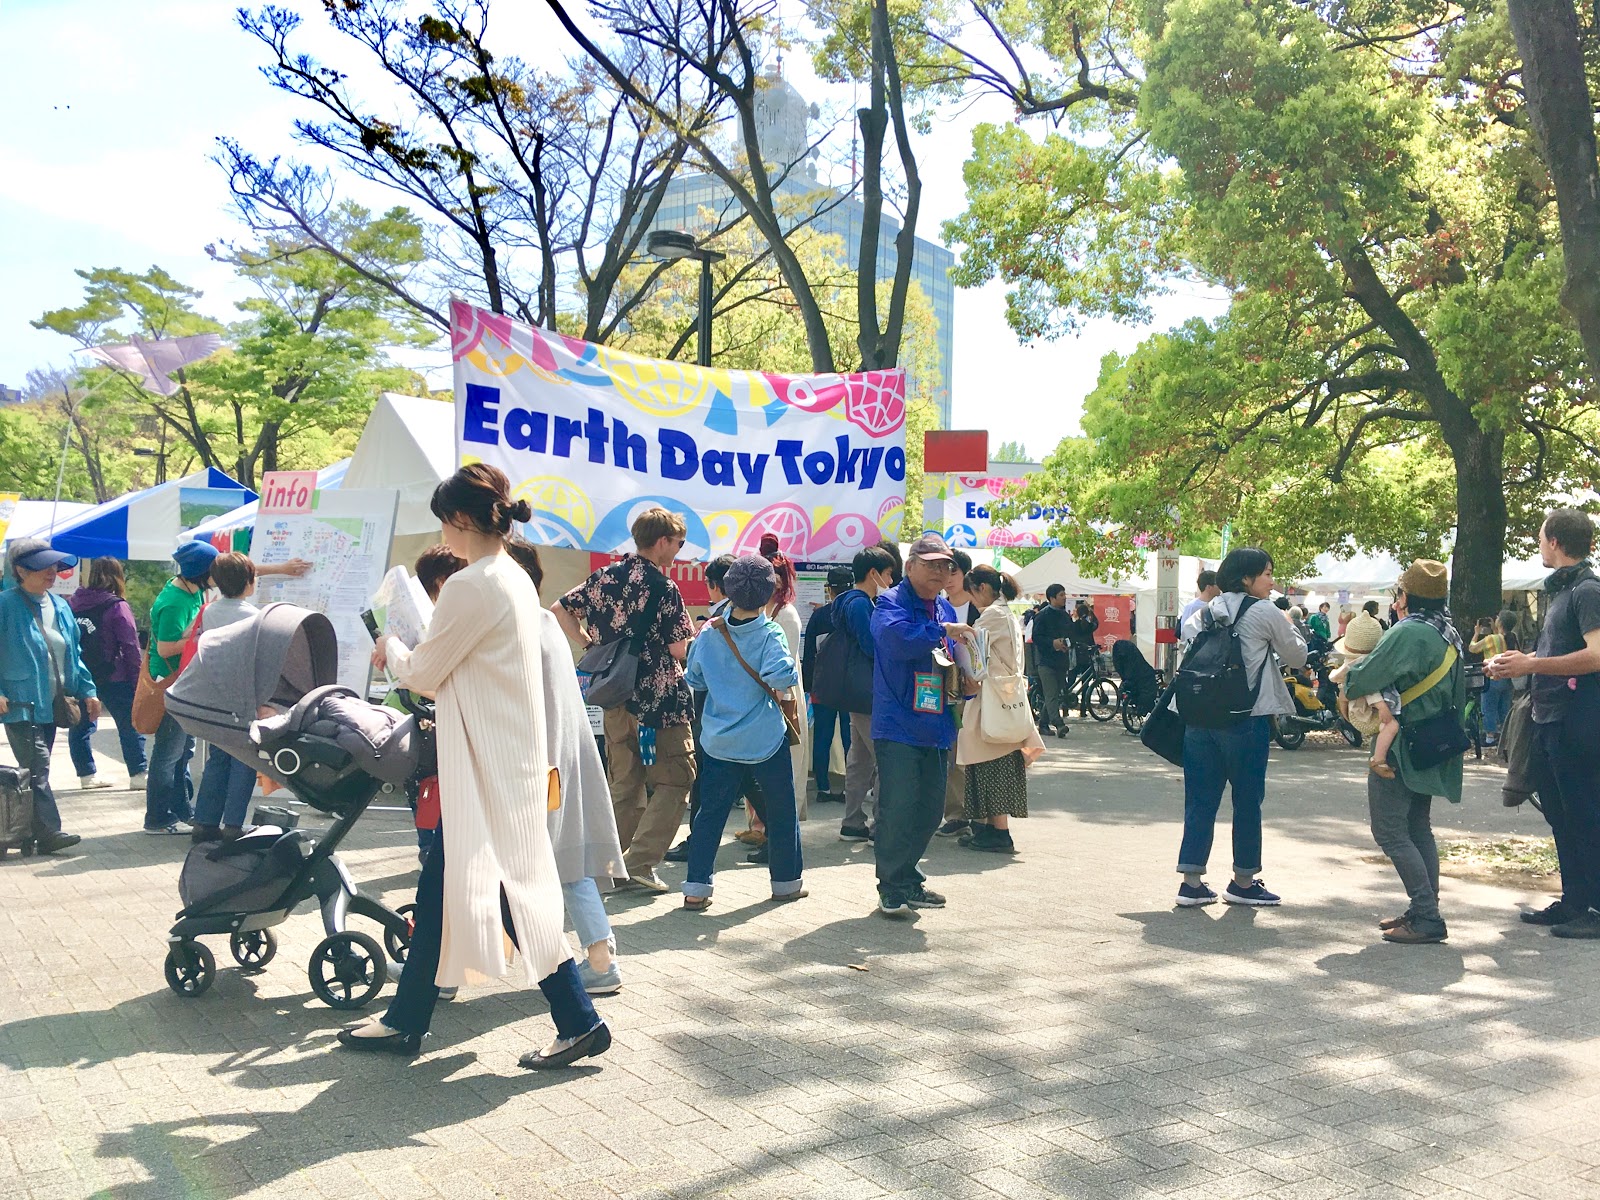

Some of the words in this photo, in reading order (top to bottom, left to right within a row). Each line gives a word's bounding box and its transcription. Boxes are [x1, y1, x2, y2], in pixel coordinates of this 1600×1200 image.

[463, 383, 648, 474] Earth
[658, 428, 770, 494] Day
[775, 434, 906, 490] Tokyo
[265, 478, 308, 508] info
